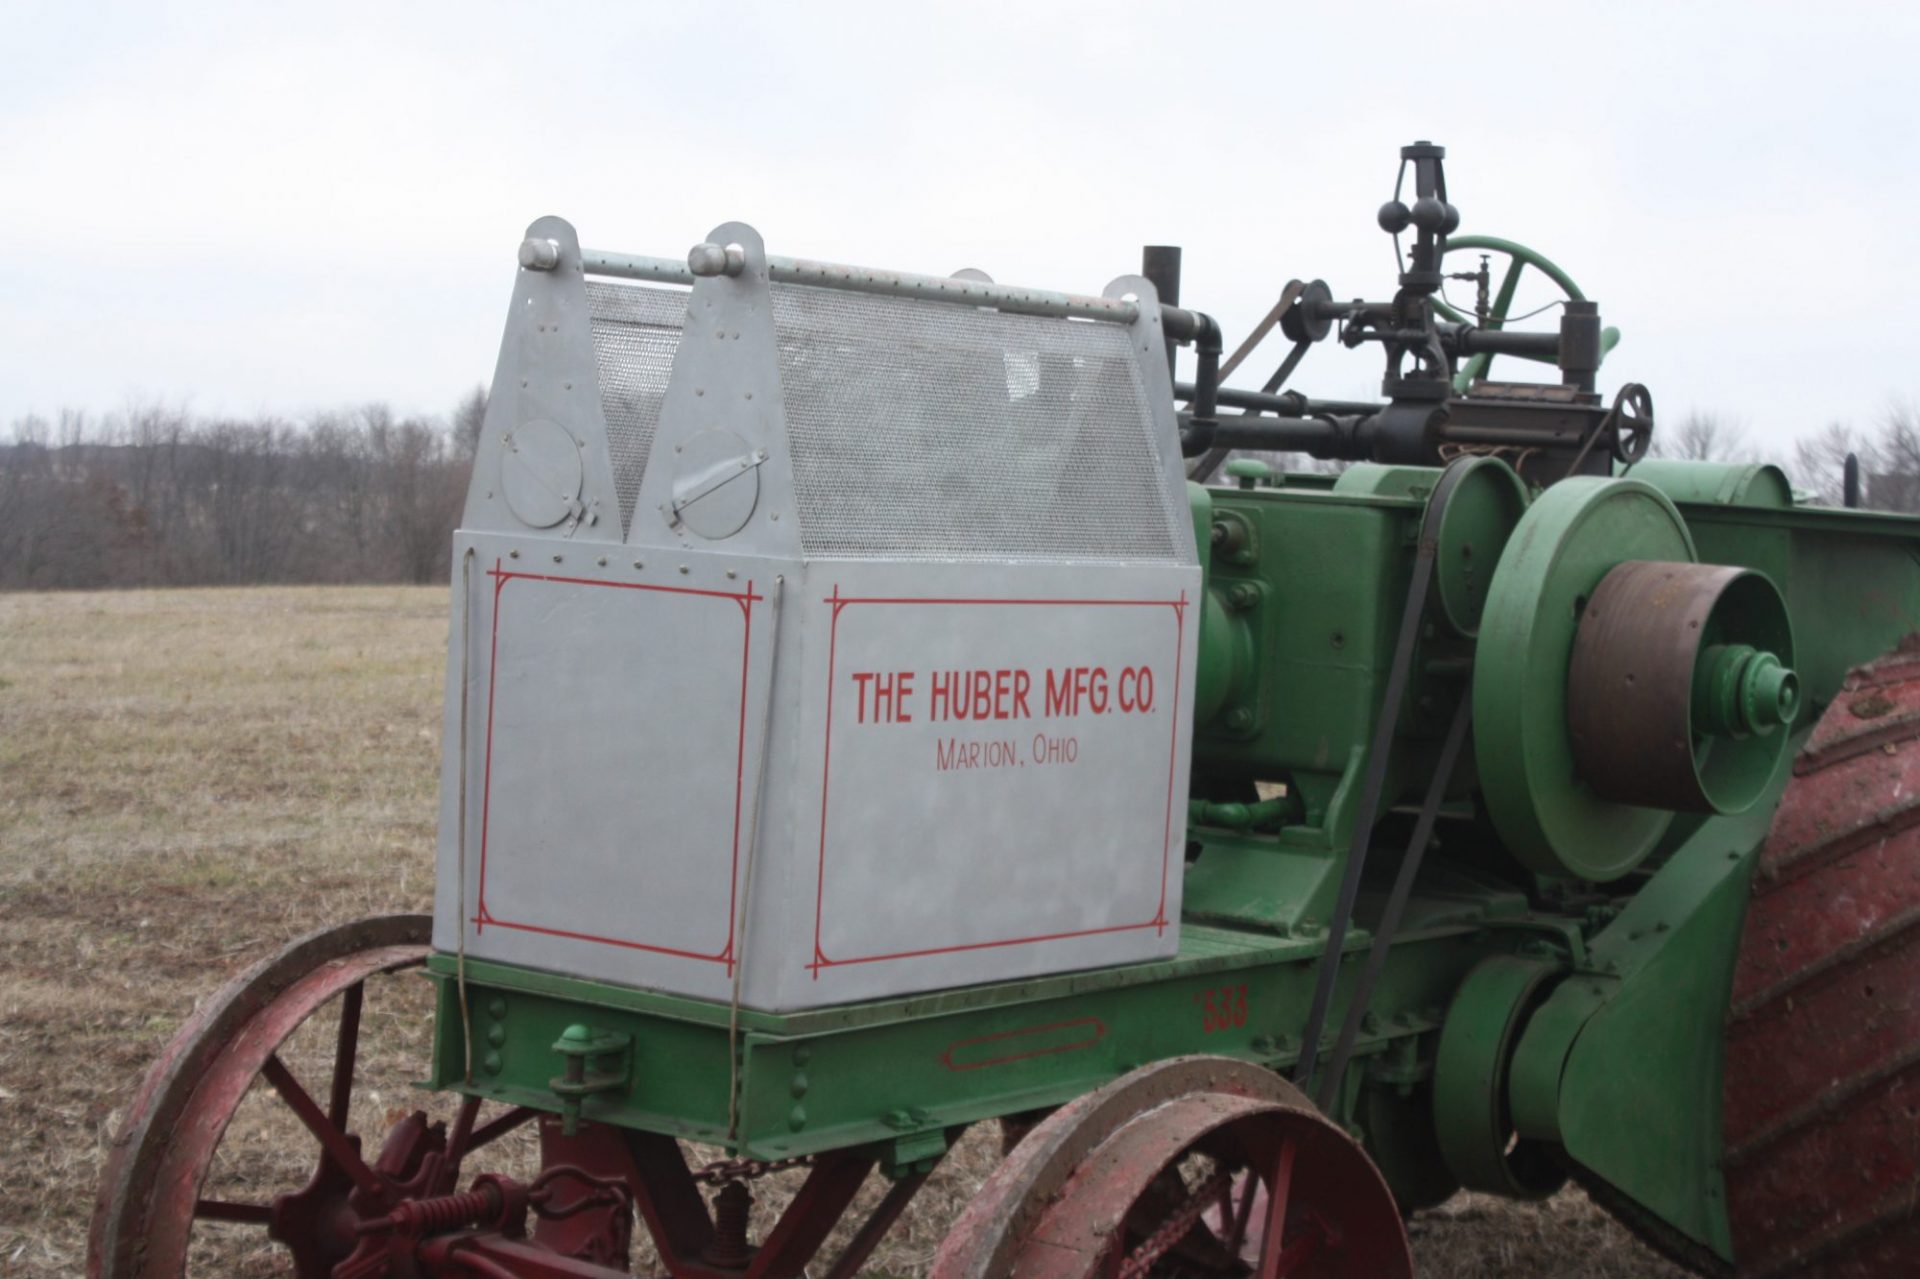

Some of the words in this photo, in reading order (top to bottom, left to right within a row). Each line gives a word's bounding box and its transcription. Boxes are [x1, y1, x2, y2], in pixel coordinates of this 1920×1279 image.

[851, 672, 914, 724] THE
[930, 669, 1032, 722] HUBER
[936, 737, 1025, 771] MARION,
[1032, 733, 1079, 764] OHIO
